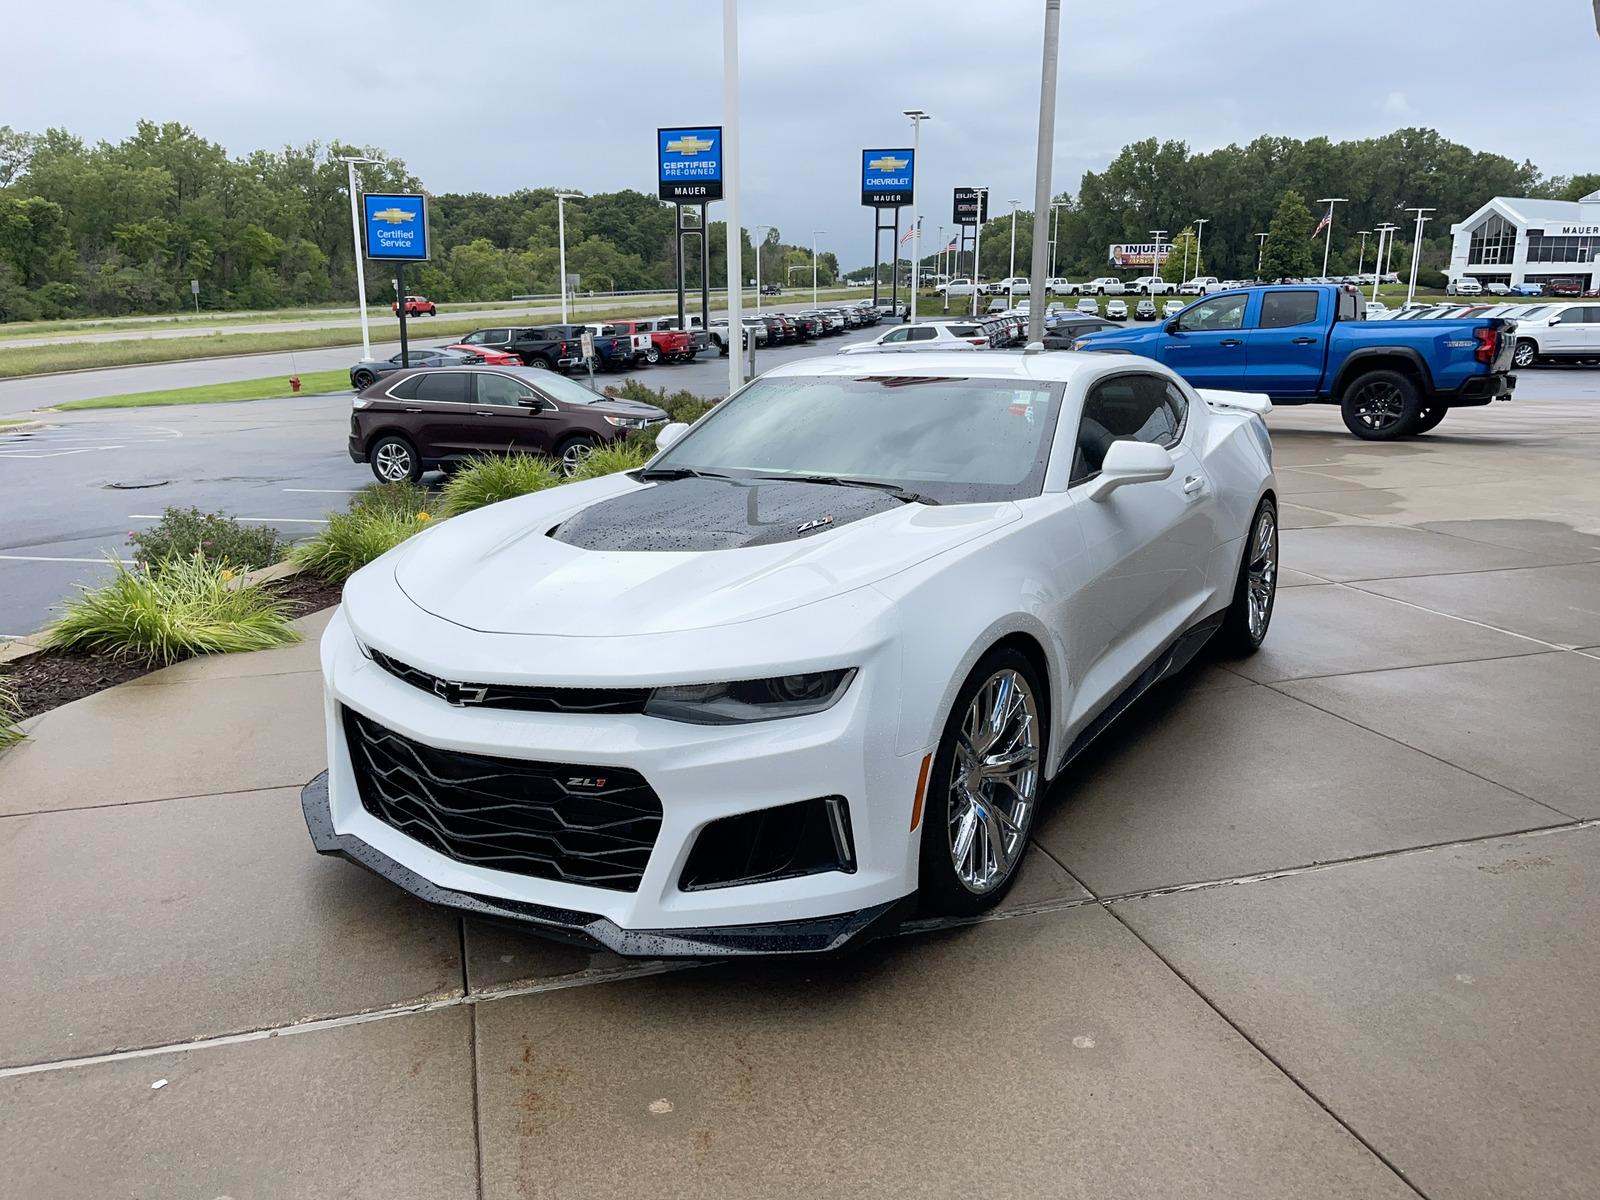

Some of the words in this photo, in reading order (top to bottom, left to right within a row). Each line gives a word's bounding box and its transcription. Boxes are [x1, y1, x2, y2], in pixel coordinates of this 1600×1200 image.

[663, 161, 717, 169] CERTIFIED
[665, 168, 715, 176] PRE-OWNED
[674, 186, 706, 195] MAUER
[873, 194, 901, 202] MAUER
[376, 229, 414, 239] Certified
[1562, 226, 1599, 235] MAUER
[380, 239, 412, 248] Service
[566, 777, 606, 788] ZL1
